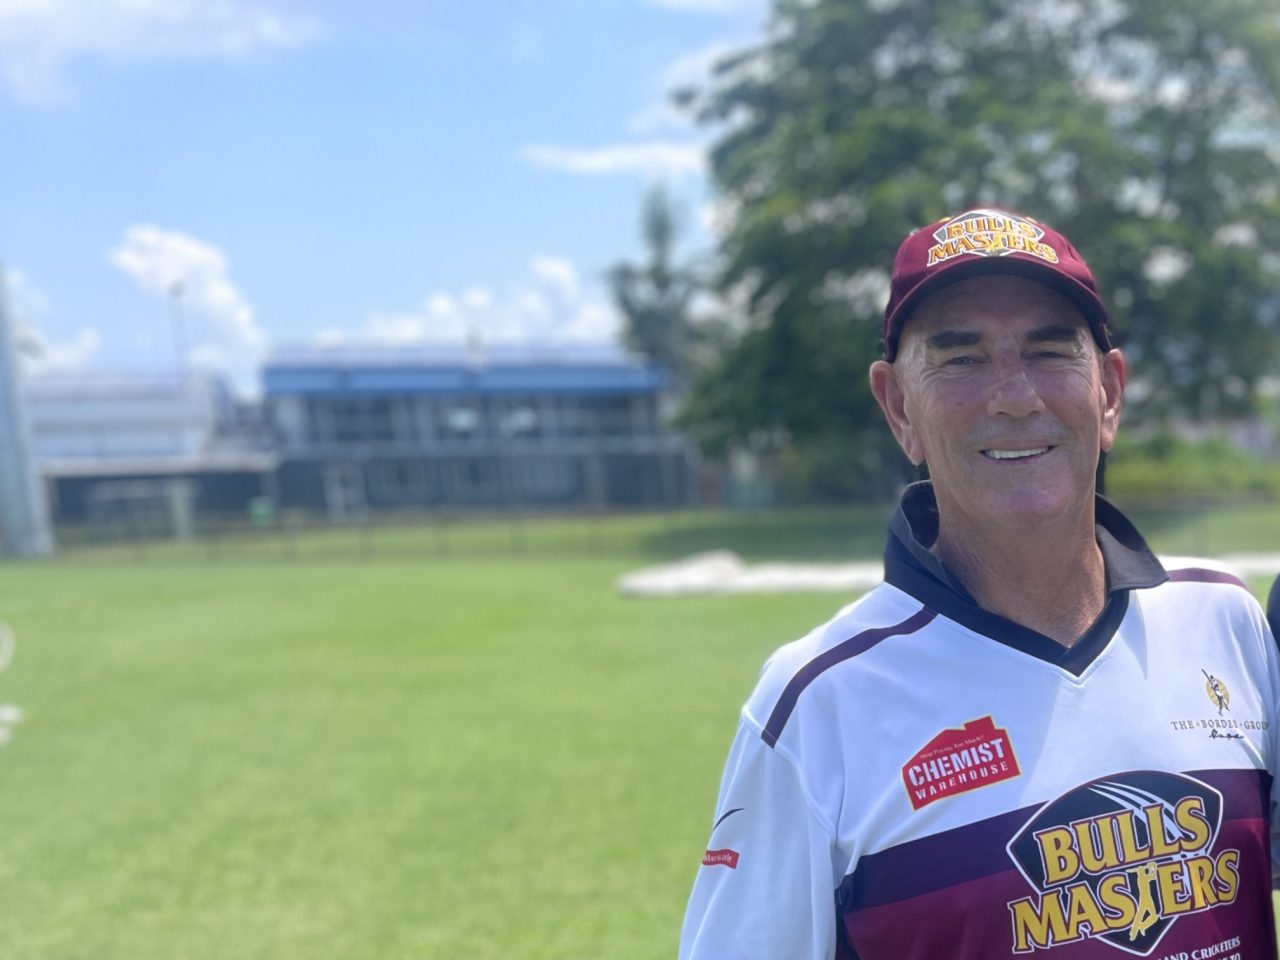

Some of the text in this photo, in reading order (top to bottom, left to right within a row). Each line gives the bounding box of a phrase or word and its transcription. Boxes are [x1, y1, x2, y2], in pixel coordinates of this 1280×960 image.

[945, 216, 1037, 239] BULLS
[927, 231, 1059, 267] MASTERS
[1171, 719, 1269, 731] THE BORDER GROU
[908, 738, 1004, 787] CHEMIST
[915, 761, 1009, 800] WAREHOUSE
[1032, 796, 1213, 889] BULLS
[1007, 849, 1241, 954] MASTERS
[1191, 936, 1241, 960] CRICKETERS
